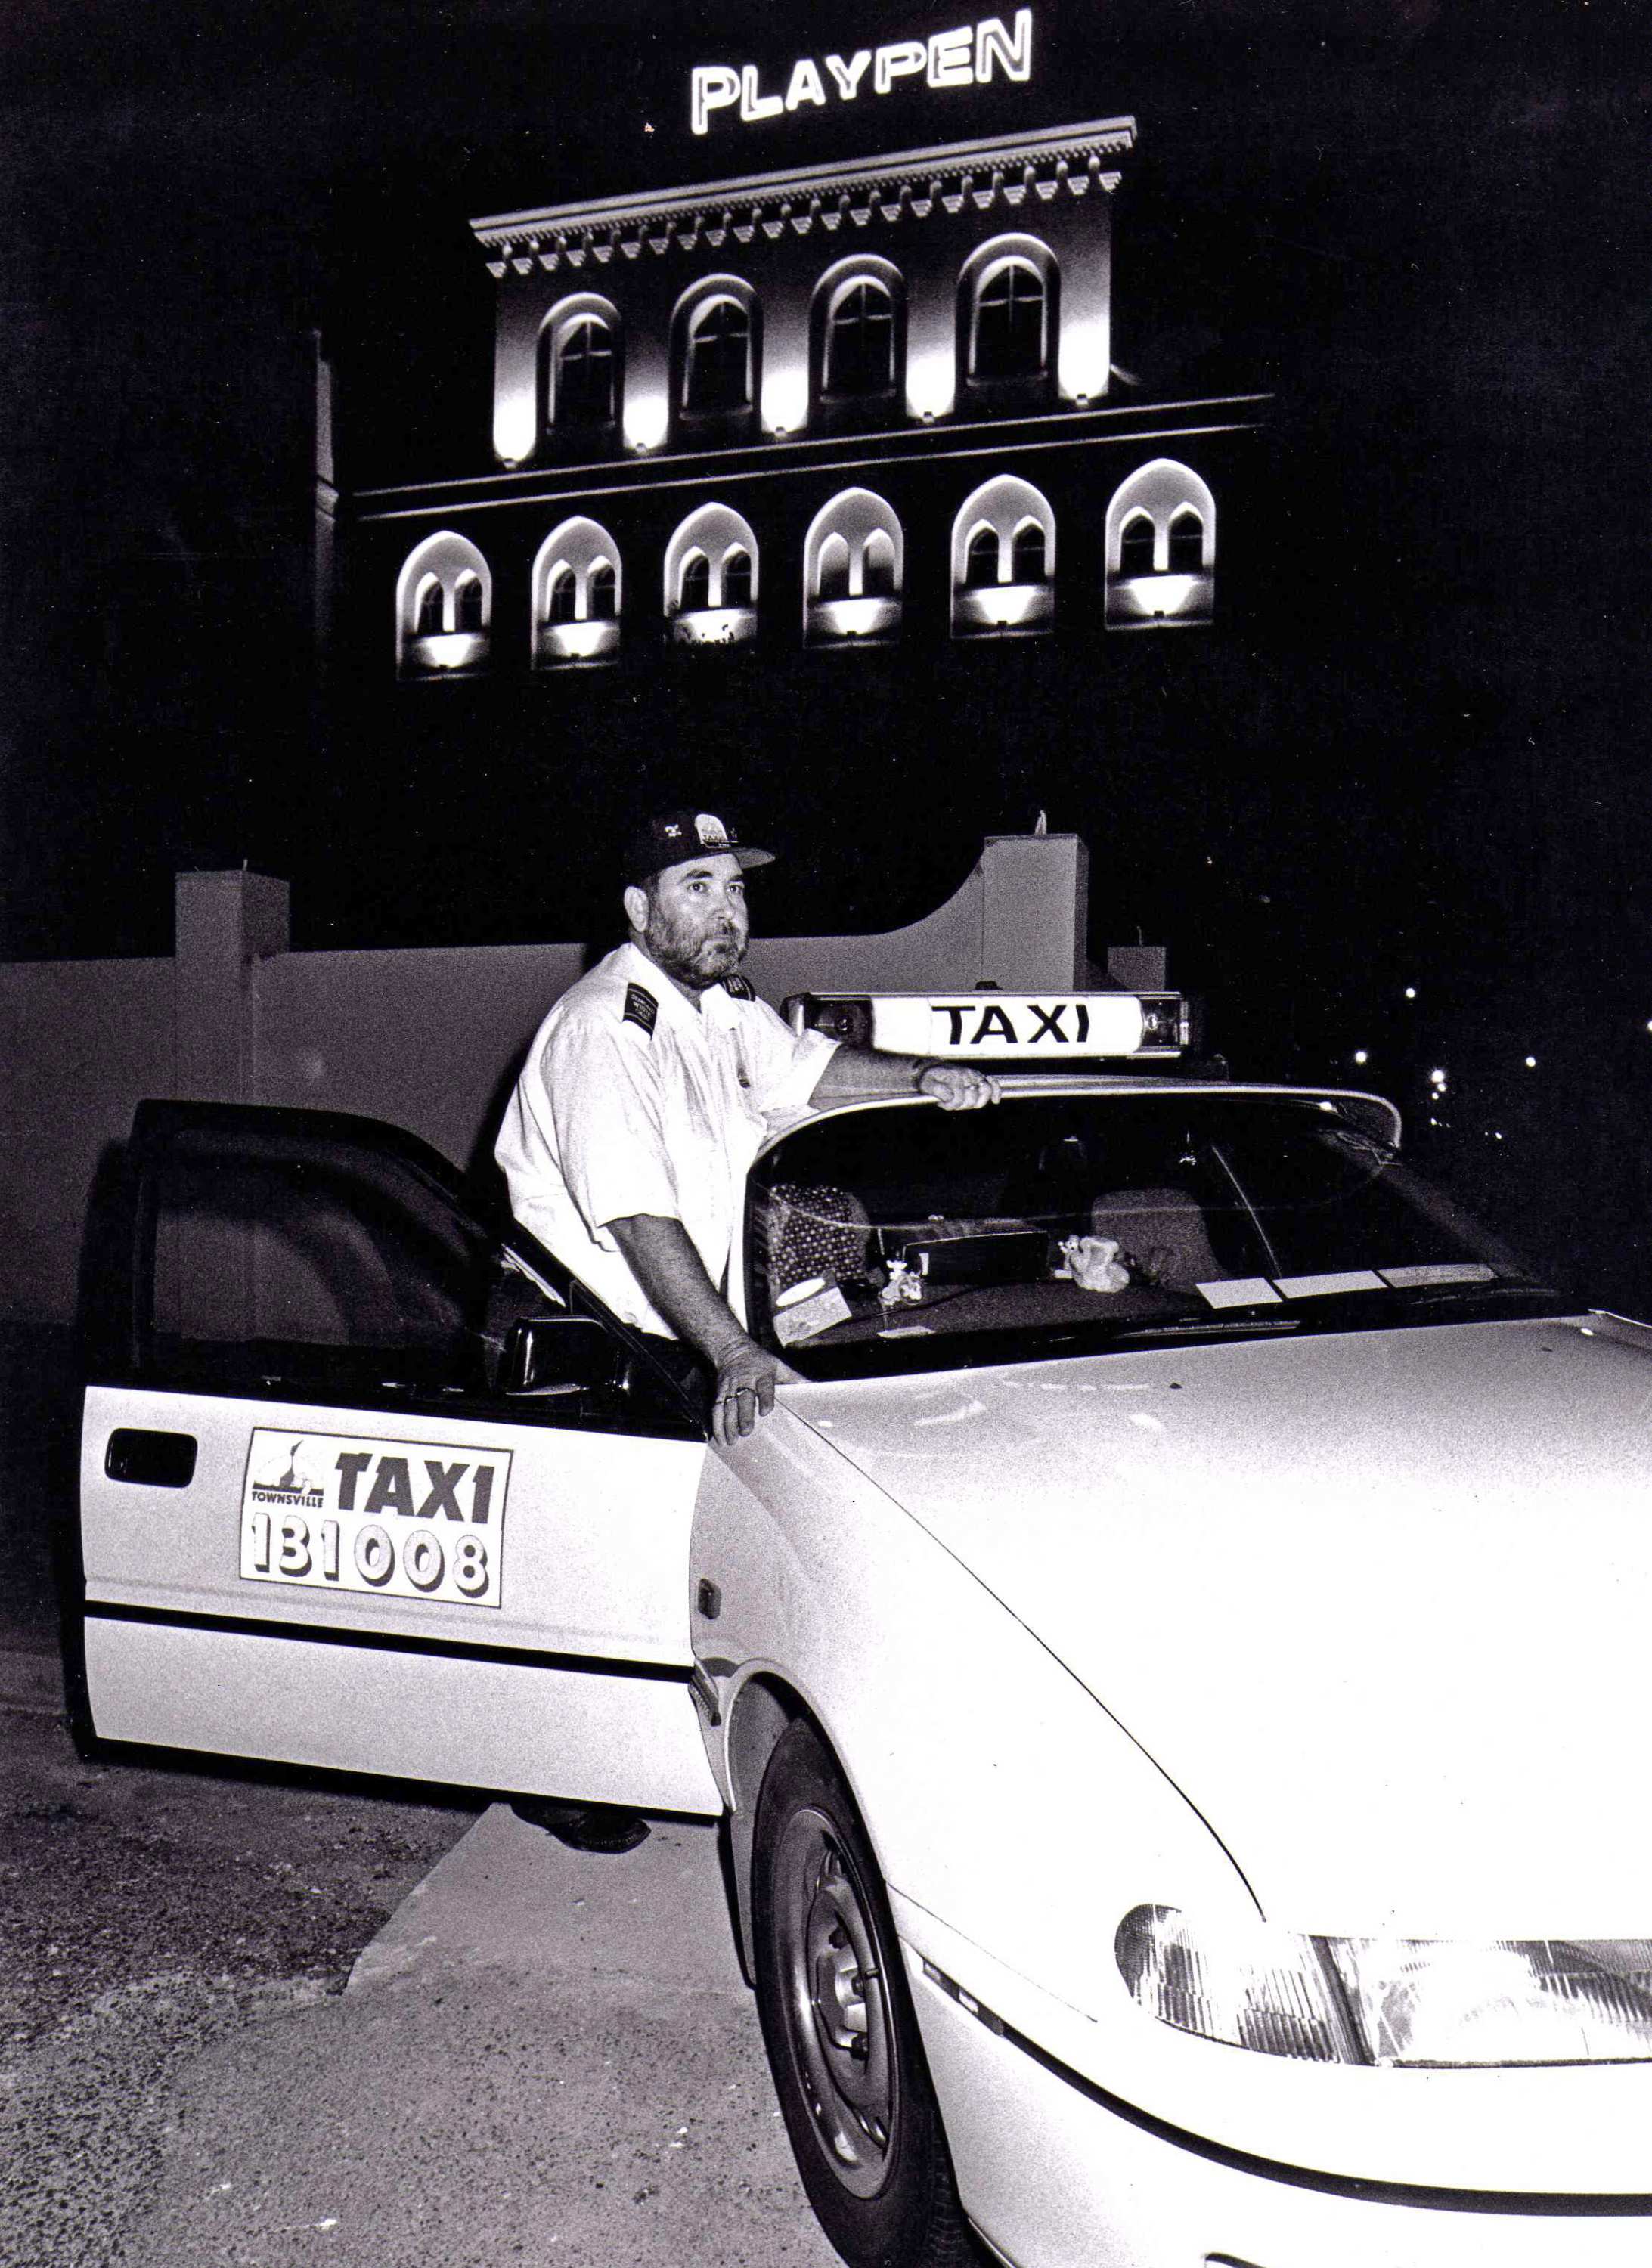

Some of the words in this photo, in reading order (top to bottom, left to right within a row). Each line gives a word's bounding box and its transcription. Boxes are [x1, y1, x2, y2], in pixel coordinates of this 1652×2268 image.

[691, 8, 1033, 135] PLAYPEN
[932, 1005, 1089, 1045] TAXI
[252, 1490, 324, 1508] TOWNSVILLE
[251, 1512, 490, 1598] 131008
